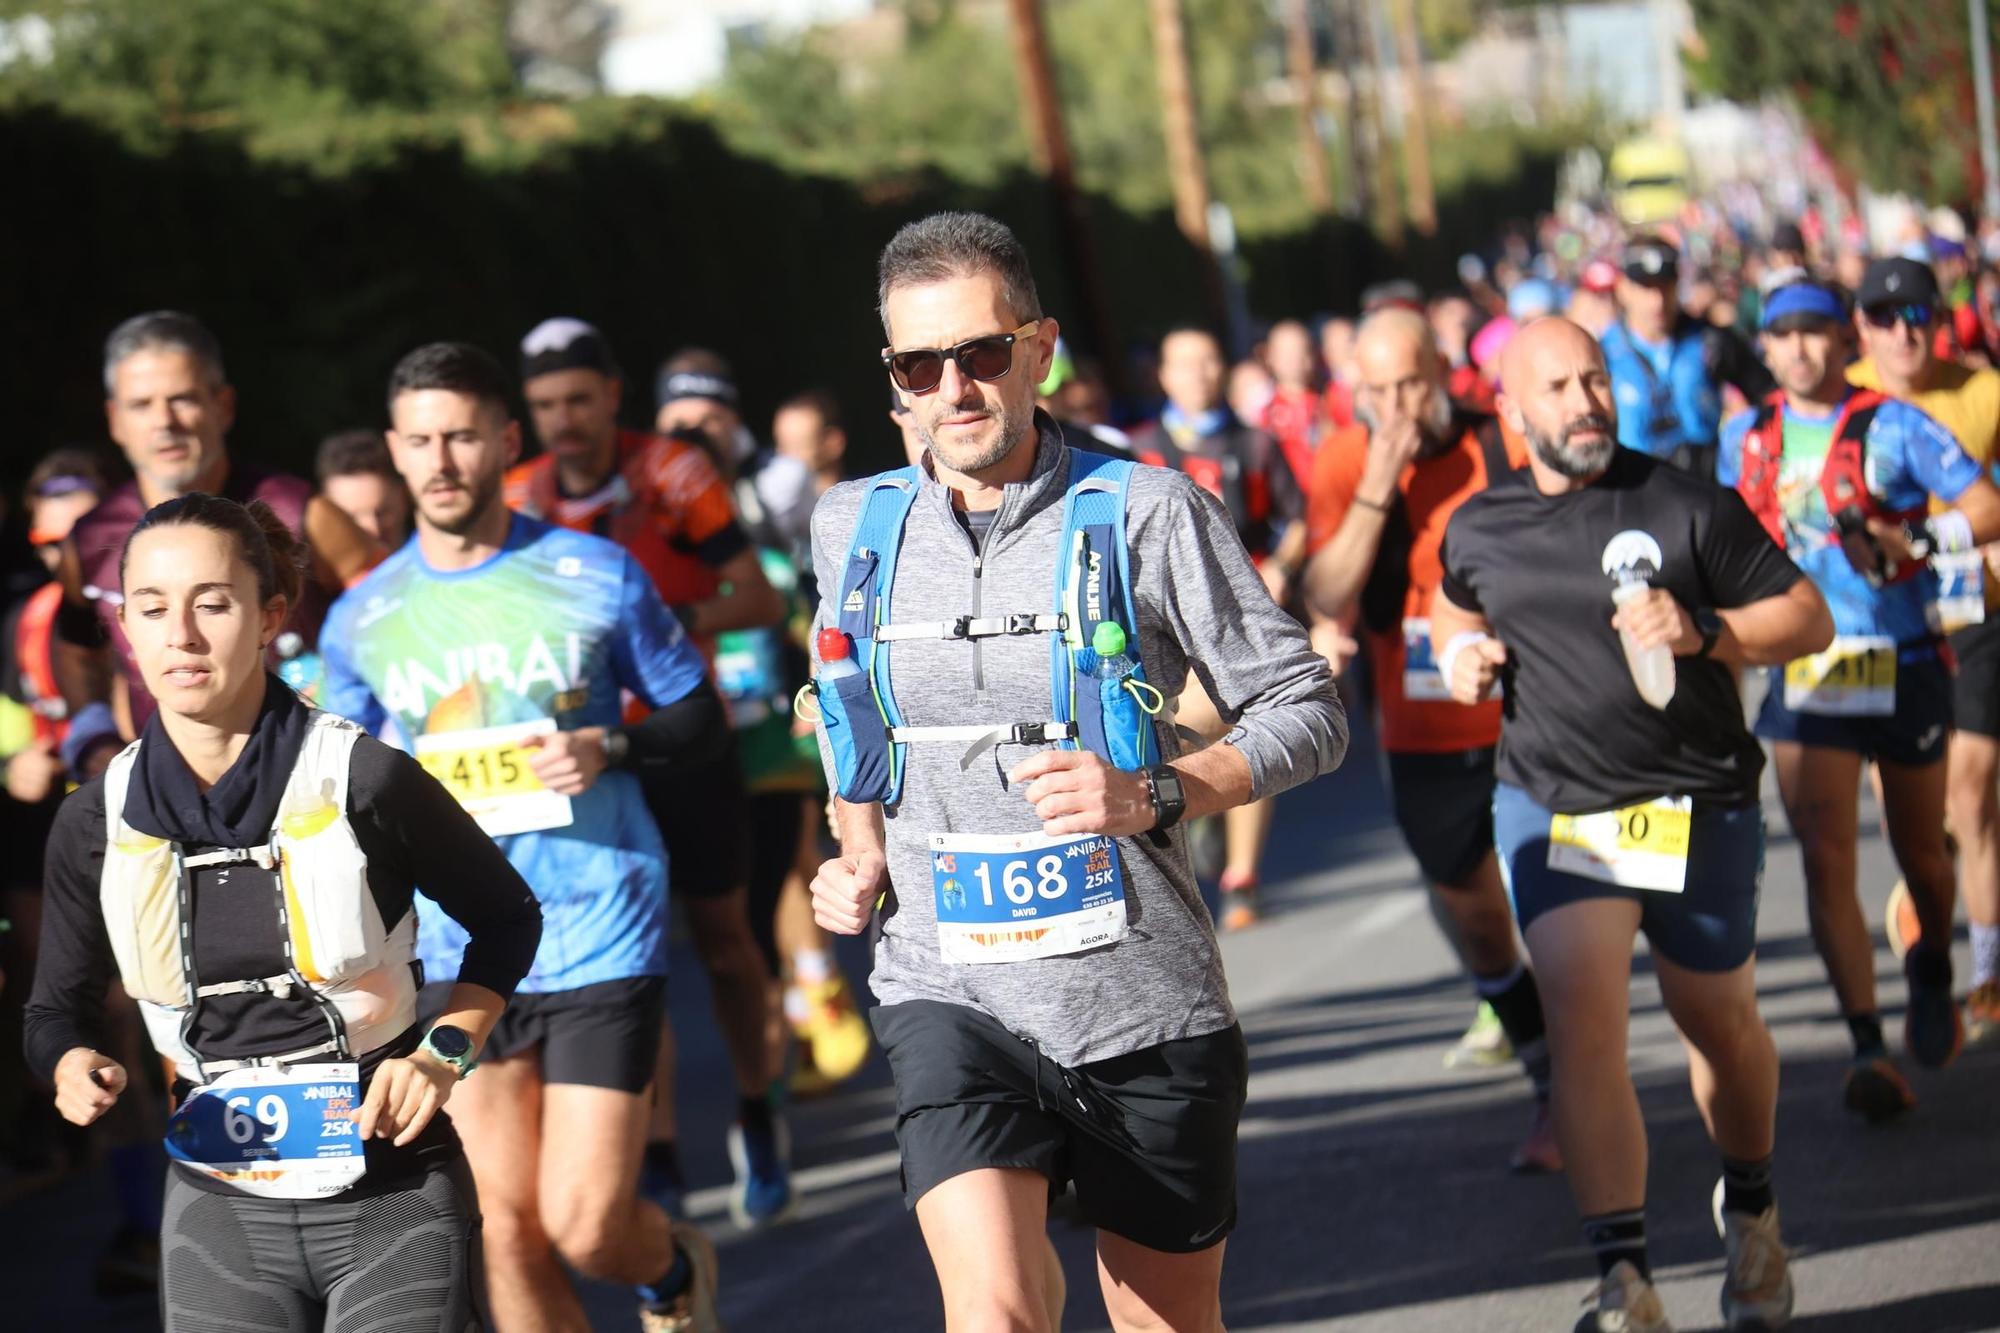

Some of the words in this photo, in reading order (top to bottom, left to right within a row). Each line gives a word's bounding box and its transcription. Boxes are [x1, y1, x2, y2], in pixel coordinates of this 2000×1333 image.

[1064, 837, 1111, 859] ANIBAL
[1089, 850, 1110, 863] EPIC
[1084, 858, 1112, 874] TRAIL
[974, 854, 1068, 906] 168
[1085, 869, 1114, 889] 25K
[1012, 907, 1037, 918] DAVID
[303, 1085, 355, 1100] ANIBAL
[224, 1095, 289, 1144] 69
[320, 1120, 354, 1137] 25K
